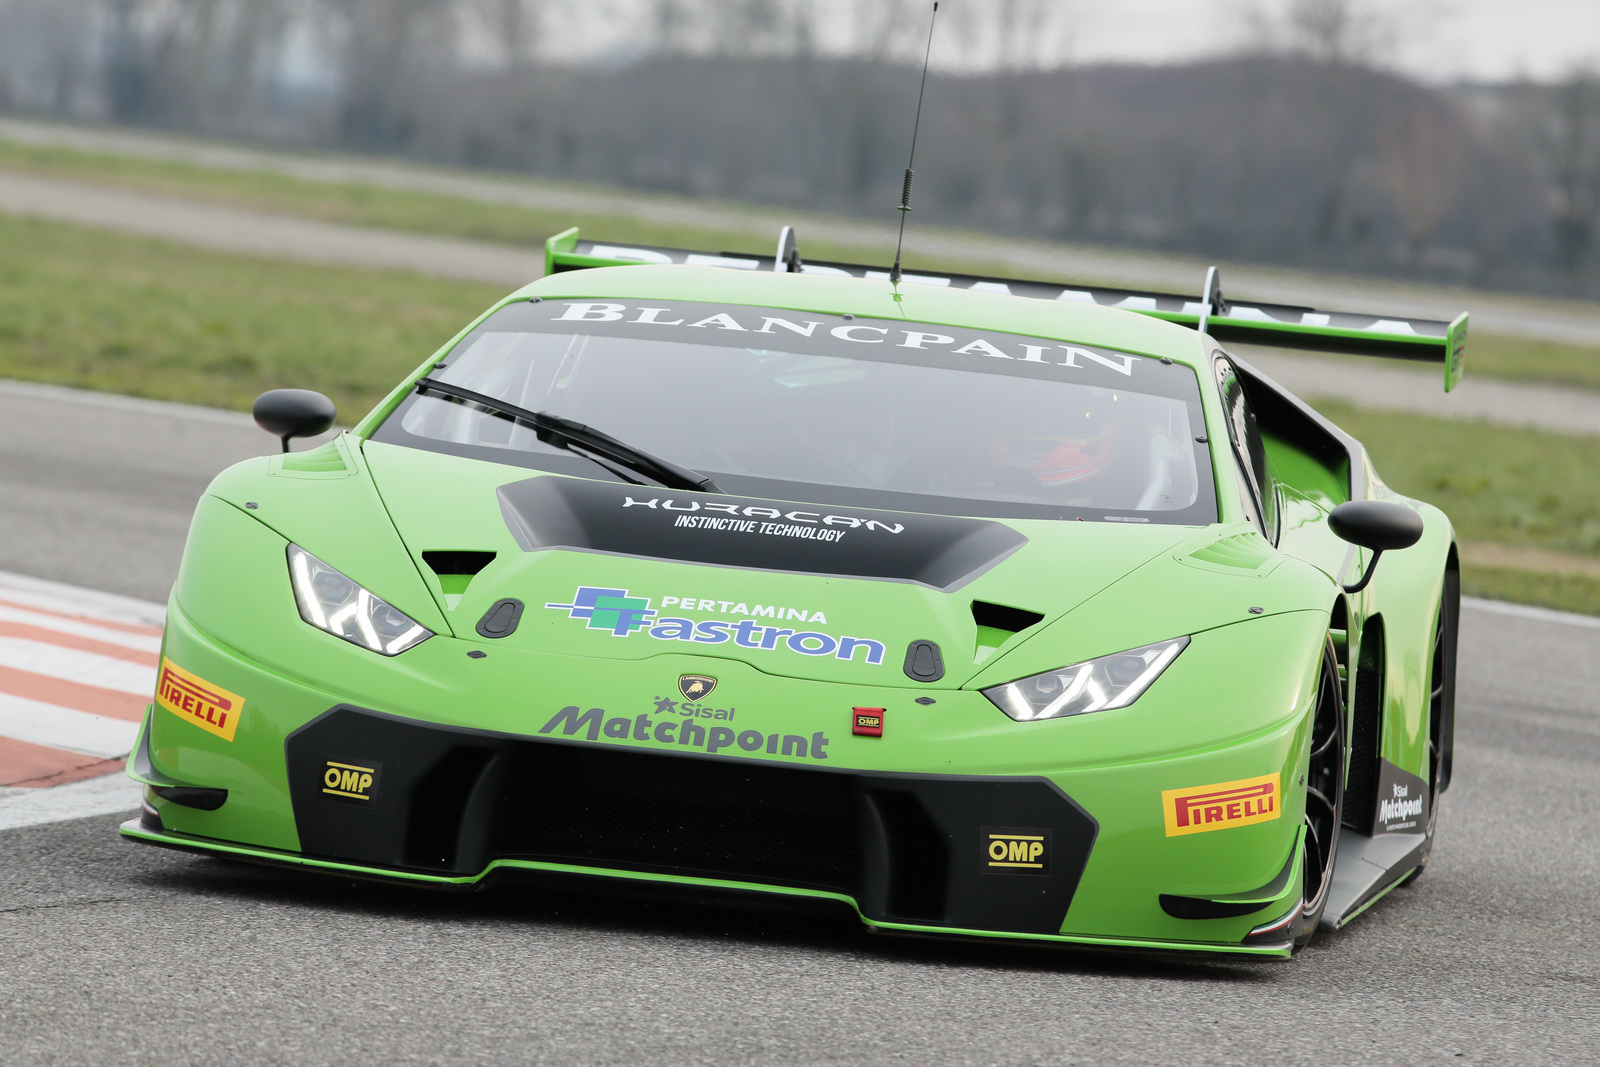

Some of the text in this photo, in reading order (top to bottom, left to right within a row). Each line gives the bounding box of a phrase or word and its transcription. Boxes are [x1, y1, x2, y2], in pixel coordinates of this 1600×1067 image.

[550, 302, 1136, 377] BLANCPAIN
[674, 515, 846, 543] INSTINCTIVE TECHNOLOGY
[661, 595, 828, 625] PERTAMINA
[611, 606, 886, 666] Fastron
[159, 666, 232, 729] PIRELLI
[679, 702, 736, 722] Sisal
[538, 705, 830, 760] Matchpoint
[858, 718, 880, 726] OMP
[324, 767, 373, 793] OMP
[1174, 782, 1274, 828] PIRELLI
[1378, 794, 1423, 825] Matchpoint
[988, 840, 1044, 862] OMP
